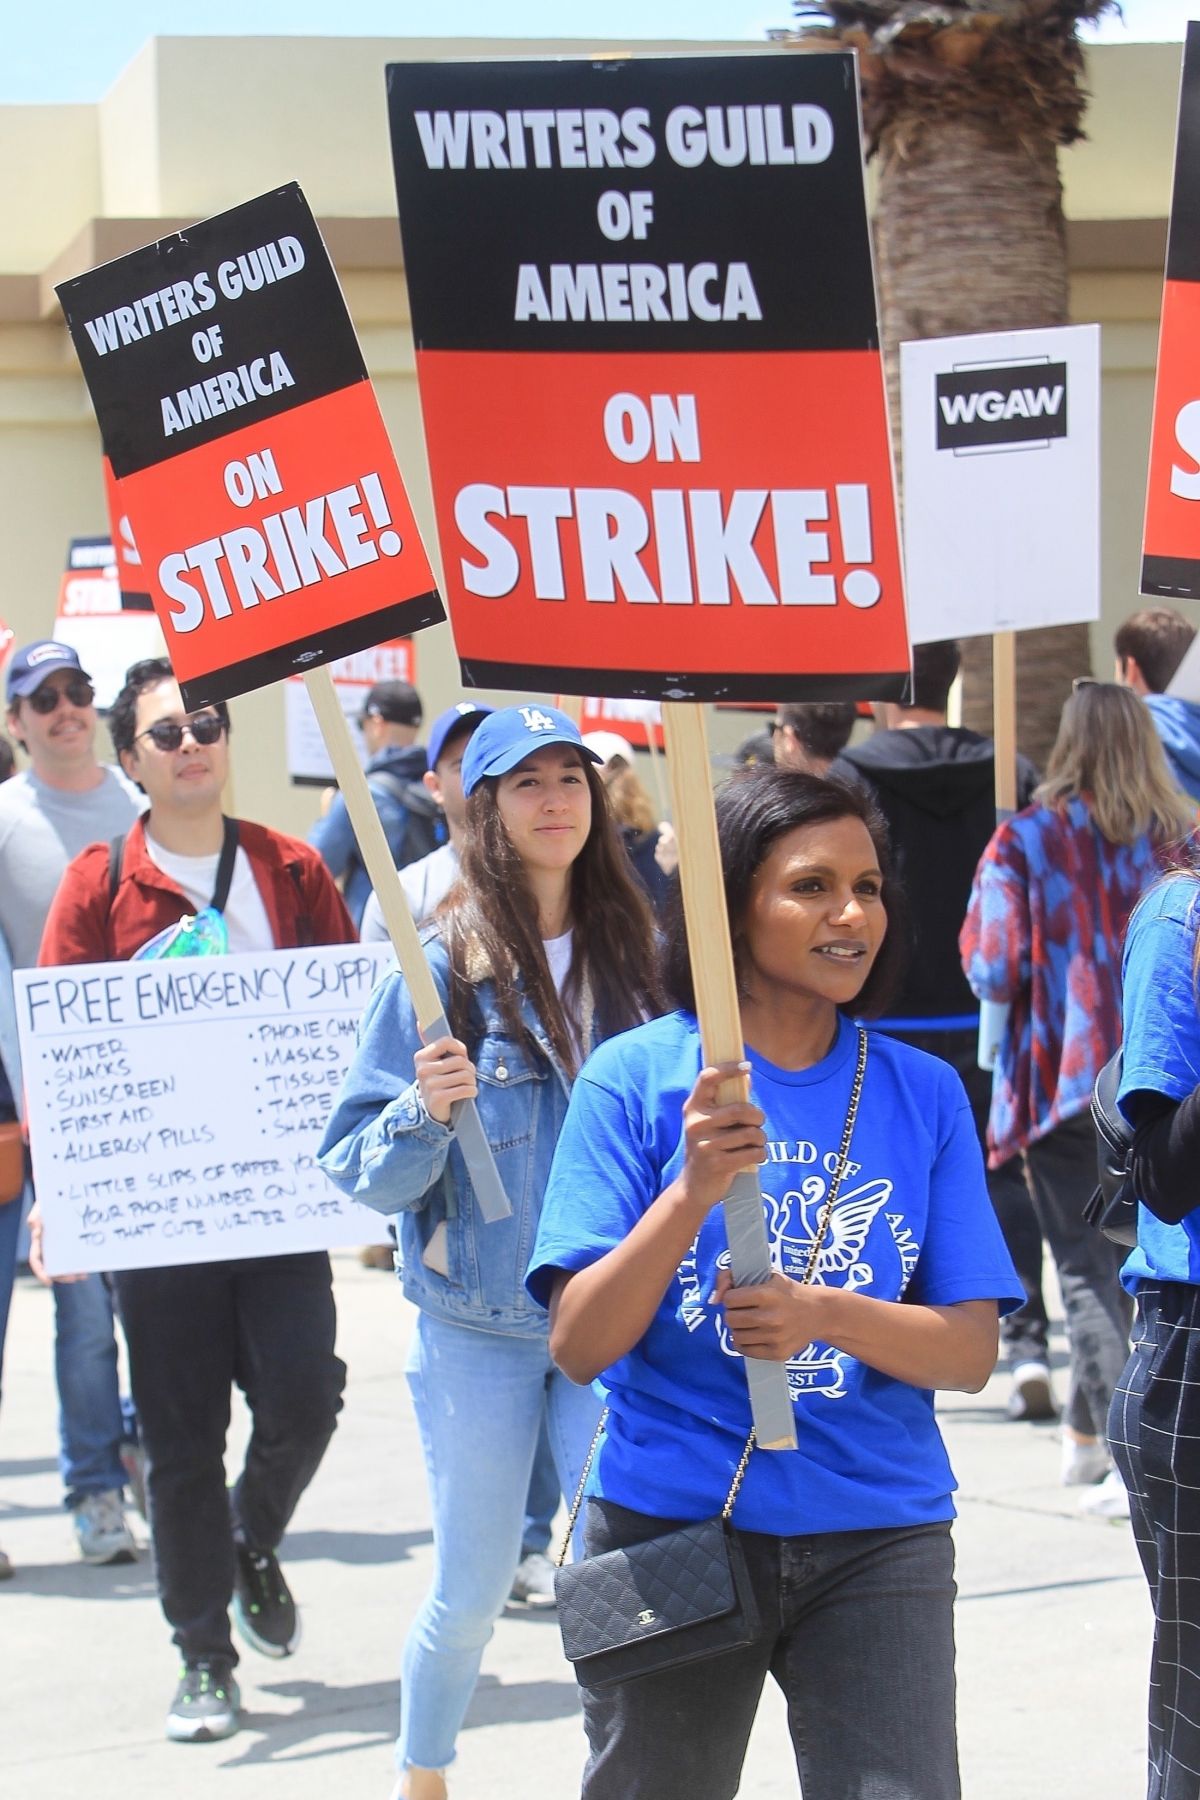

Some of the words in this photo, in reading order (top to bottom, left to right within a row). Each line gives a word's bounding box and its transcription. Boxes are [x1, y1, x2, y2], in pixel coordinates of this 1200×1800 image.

[415, 108, 656, 170] WRITERS
[665, 104, 834, 167] GUILD
[597, 191, 654, 241] OF
[84, 272, 217, 357] WRITERS
[217, 235, 305, 301] GUILD
[514, 262, 763, 322] AMERICA
[191, 325, 224, 364] OF
[160, 351, 295, 437] AMERICA
[938, 385, 1064, 425] WGAW
[603, 392, 702, 464] ON
[224, 448, 284, 508] ON
[158, 473, 402, 634] STRIKE!
[454, 483, 882, 609] STRIKE!
[518, 707, 557, 732] LA
[26, 976, 124, 1032] FREE
[136, 960, 296, 1020] EMERGENCY
[259, 1021, 322, 1042] PHONE
[327, 1018, 359, 1038] CHA
[50, 1039, 127, 1063] WATER
[264, 1045, 340, 1067] MASKS
[54, 1058, 131, 1087] SNACKS
[56, 1075, 176, 1112] SUNSCREEN
[268, 1092, 332, 1114] TAPE
[59, 1113, 112, 1135] FIRST
[119, 1106, 153, 1125] AID
[64, 1130, 151, 1163] ALLERGY
[157, 1123, 215, 1149] PILLS
[69, 1176, 136, 1200] LITTLE
[147, 1168, 196, 1190] SLIPS
[203, 1164, 225, 1181] OF
[231, 1159, 283, 1178] PAPER
[77, 1203, 123, 1230] YOUR
[128, 1196, 179, 1218] PHONE
[185, 1187, 255, 1210] NUMBER
[264, 1181, 296, 1199] ON
[78, 1230, 105, 1246] TO
[676, 1231, 707, 1333] WRIT
[757, 1141, 818, 1166] ILD
[823, 1151, 862, 1181] OF
[786, 1372, 818, 1386] EST
